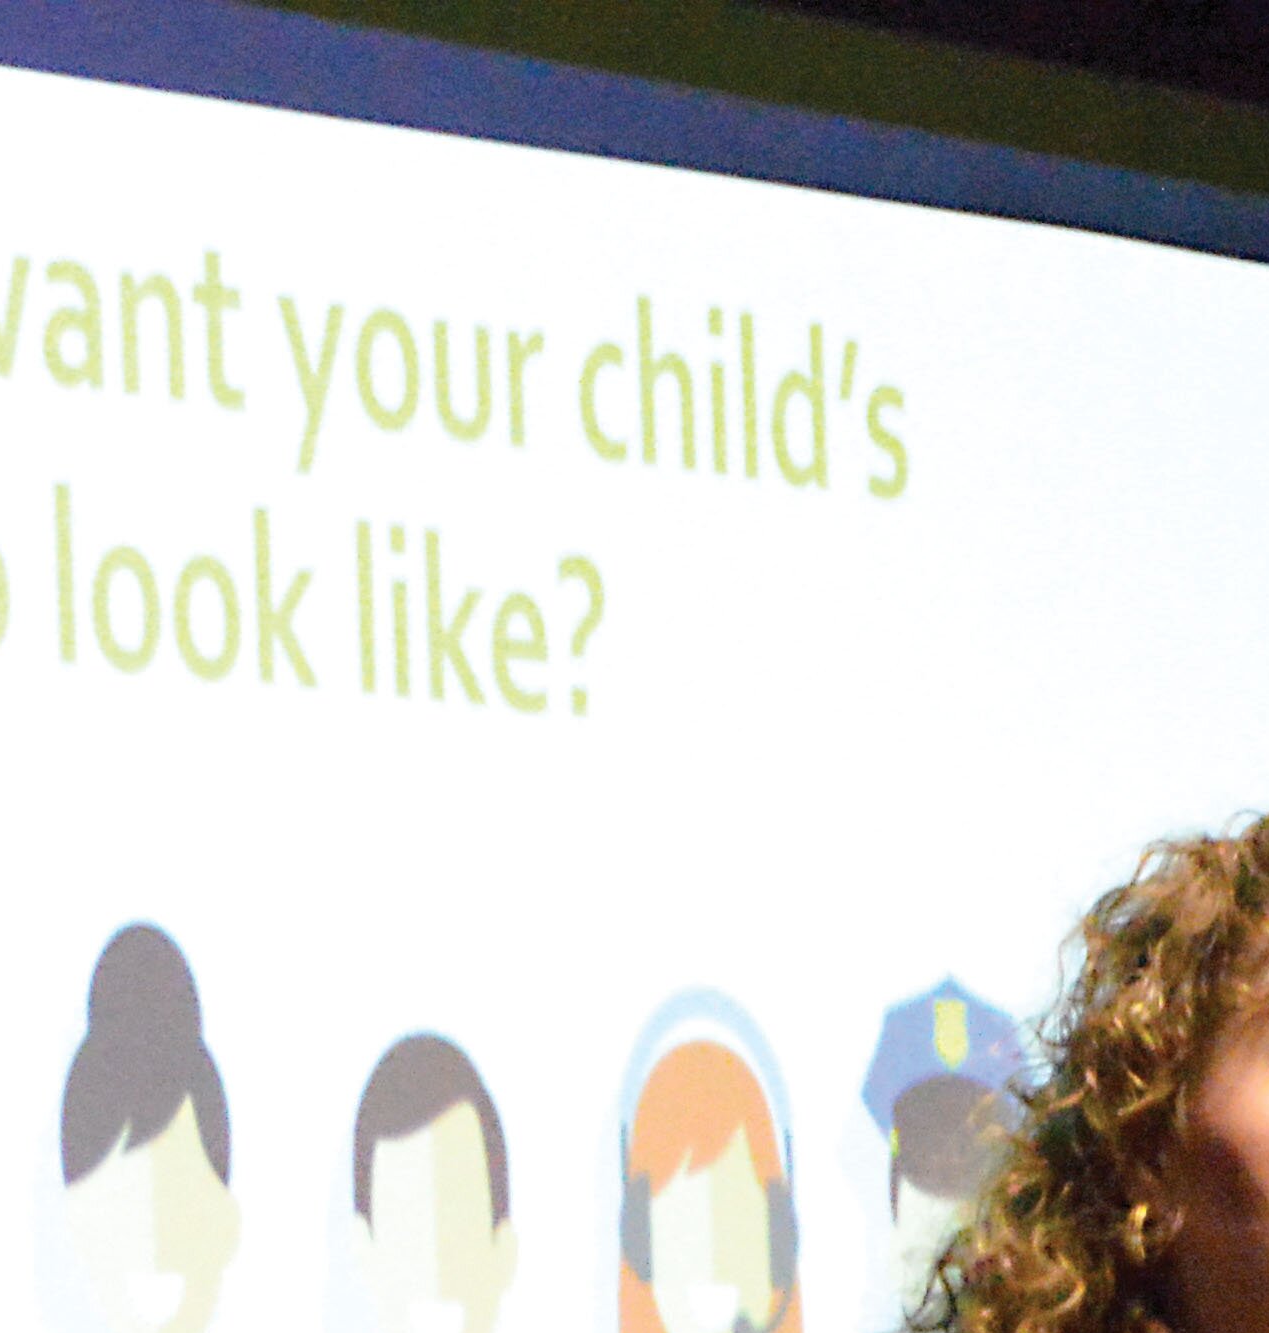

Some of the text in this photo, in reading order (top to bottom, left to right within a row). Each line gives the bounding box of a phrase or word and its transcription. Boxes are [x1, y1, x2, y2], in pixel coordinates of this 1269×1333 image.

[279, 298, 544, 472] your
[579, 296, 908, 499] child's
[56, 484, 315, 686] look
[357, 522, 604, 715] like?
